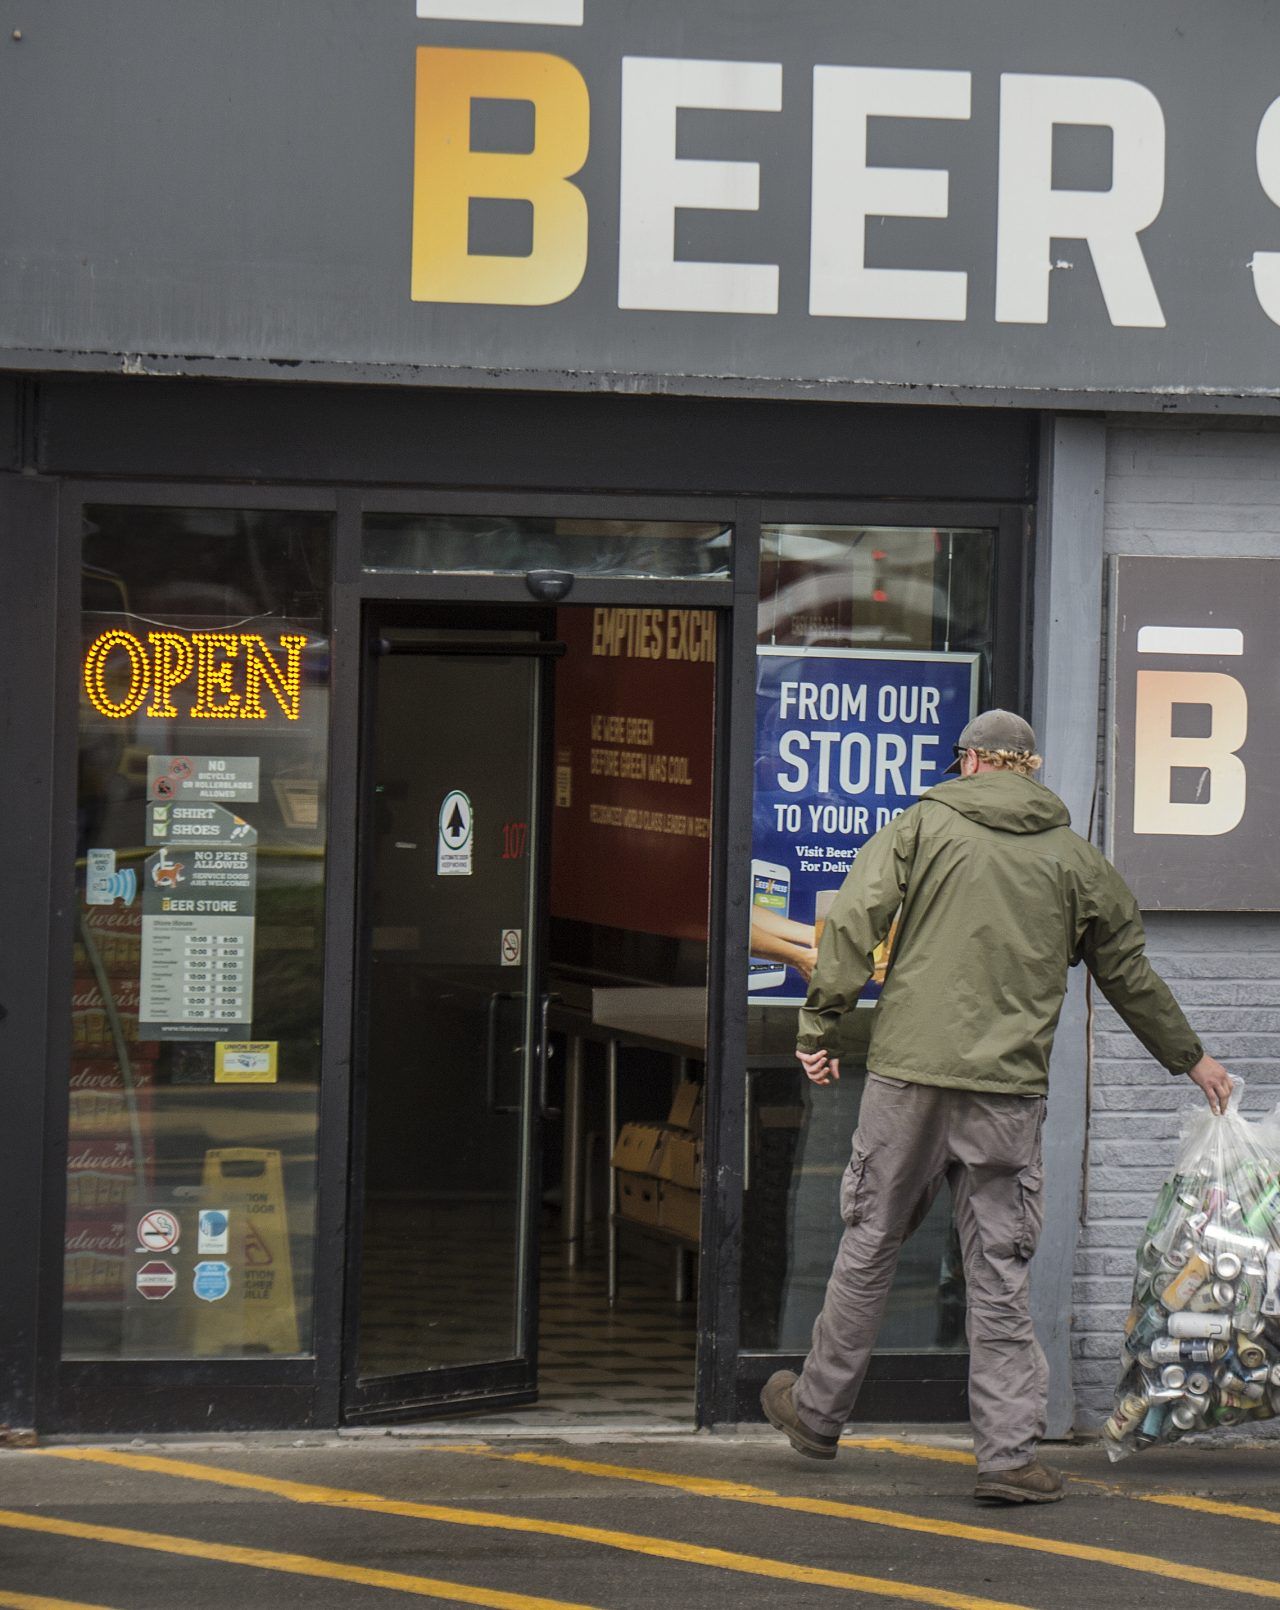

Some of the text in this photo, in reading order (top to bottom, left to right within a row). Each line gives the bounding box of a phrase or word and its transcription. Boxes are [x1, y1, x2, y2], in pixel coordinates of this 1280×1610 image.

[411, 46, 1166, 328] BEER
[592, 608, 664, 660] EMPTIES
[84, 629, 308, 719] OPEN
[779, 682, 940, 724] FROM OUR
[1134, 670, 1248, 835] B
[208, 760, 226, 771] NO
[777, 730, 940, 796] STORE
[172, 808, 216, 819] SHIRT
[773, 804, 801, 833] TO
[808, 805, 869, 835] YOUR
[172, 825, 220, 836] SHOES
[194, 852, 248, 861] NO PETS
[795, 846, 824, 857] Visit
[193, 861, 248, 869] ALLOWED
[800, 861, 821, 871] For
[162, 898, 237, 912] BEER STORE
